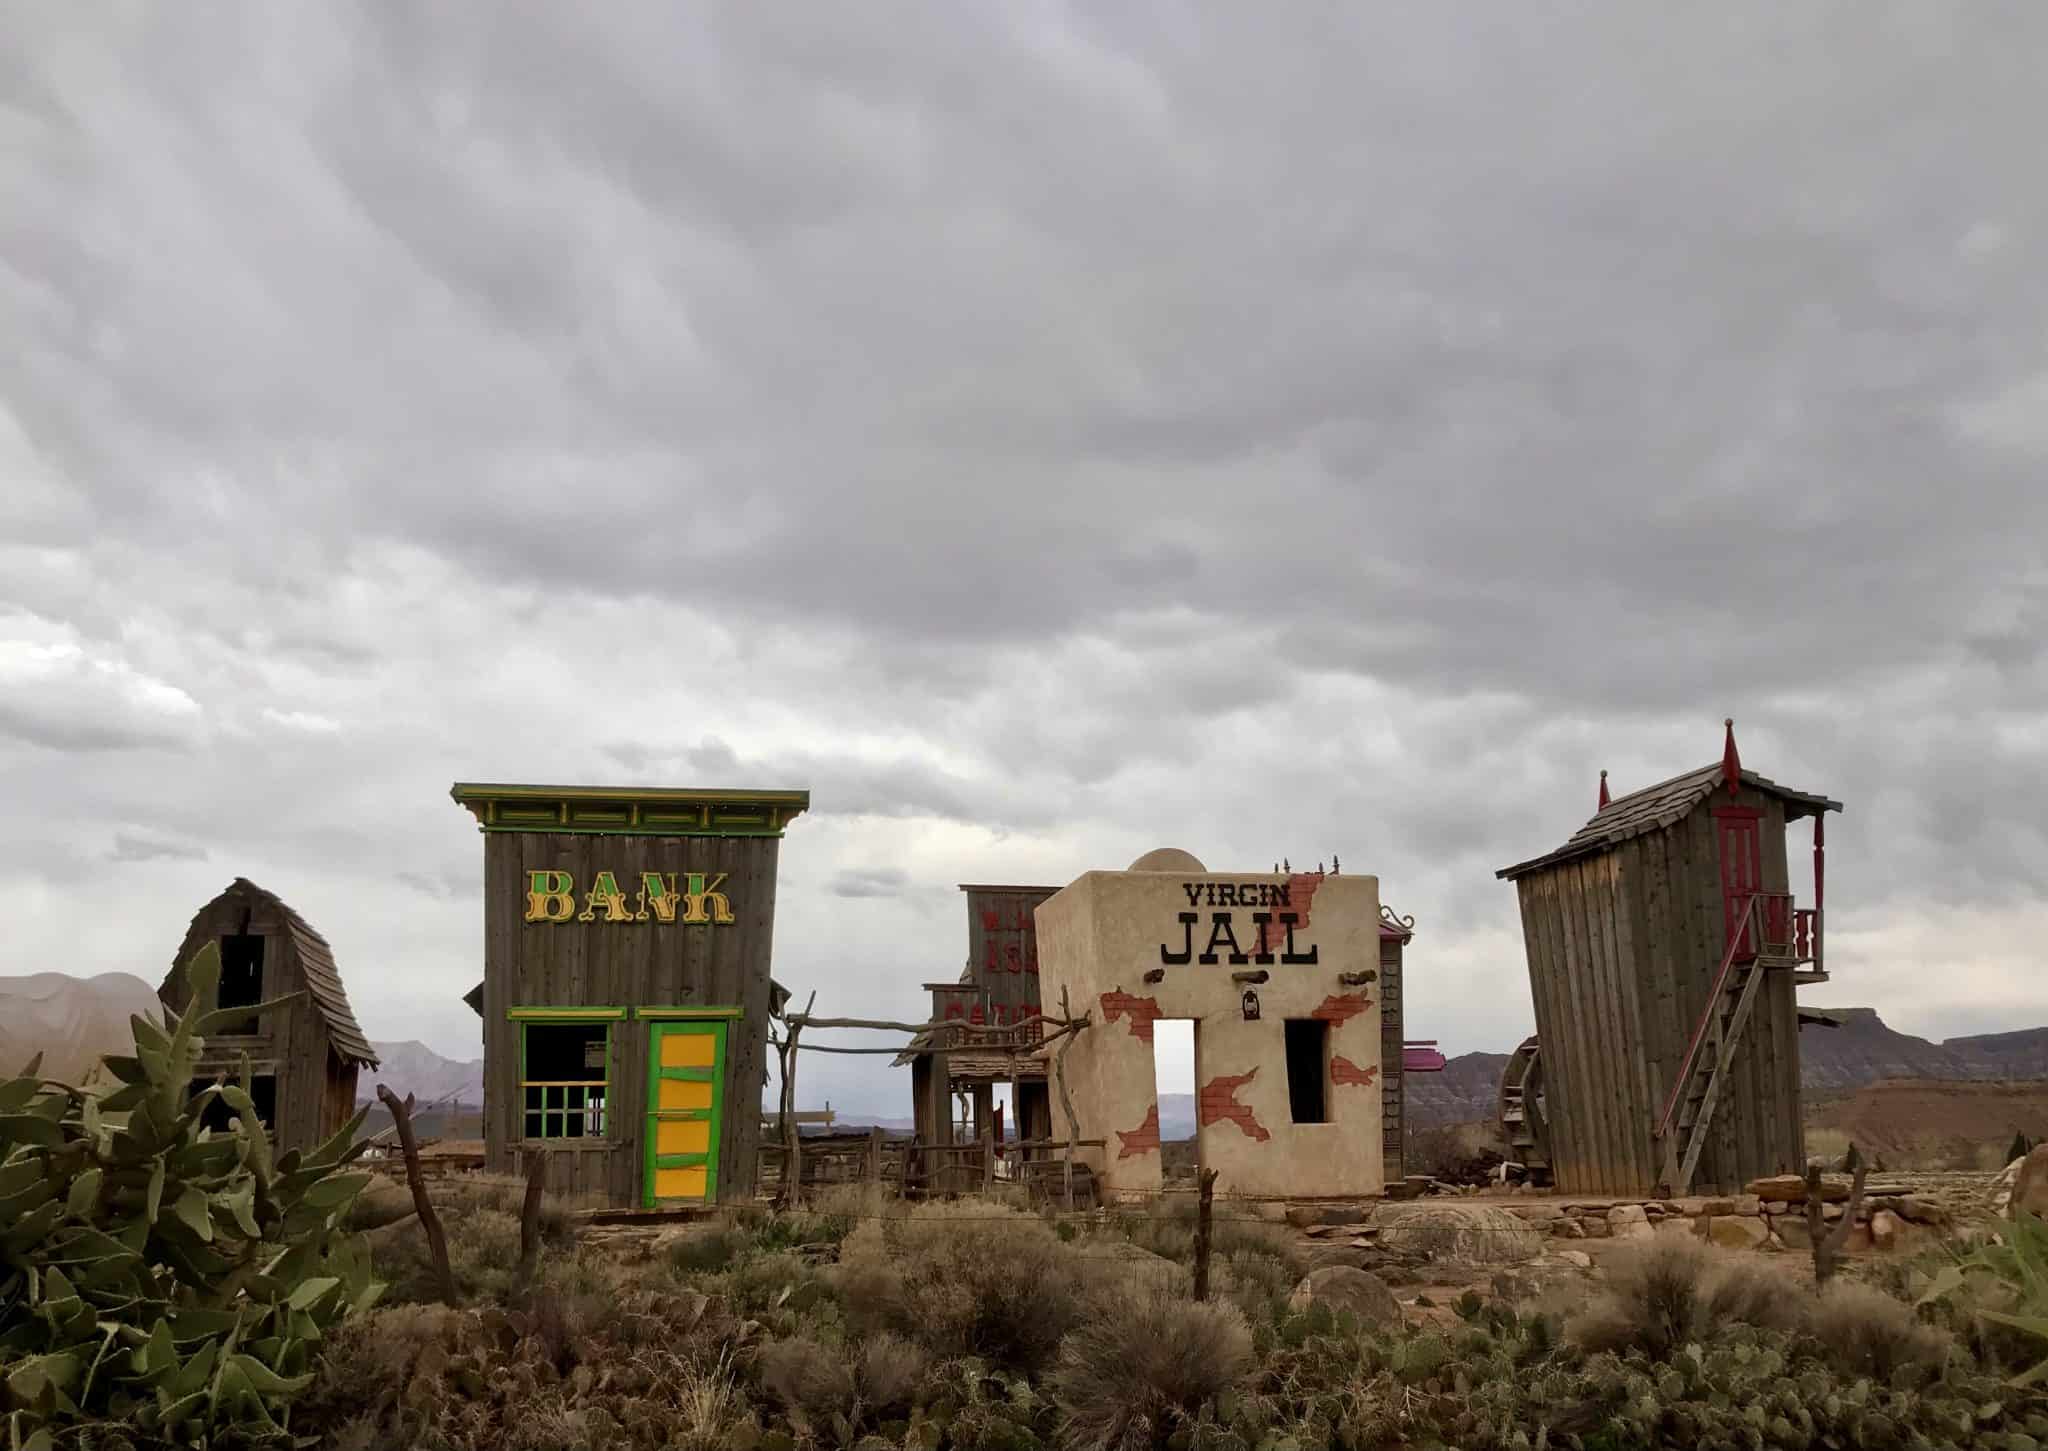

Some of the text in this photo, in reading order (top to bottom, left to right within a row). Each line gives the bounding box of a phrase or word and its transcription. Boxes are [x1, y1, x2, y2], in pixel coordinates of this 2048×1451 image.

[525, 870, 735, 923] BANK
[1182, 883, 1291, 906] VIRGIN
[1160, 912, 1318, 964] JAIL
